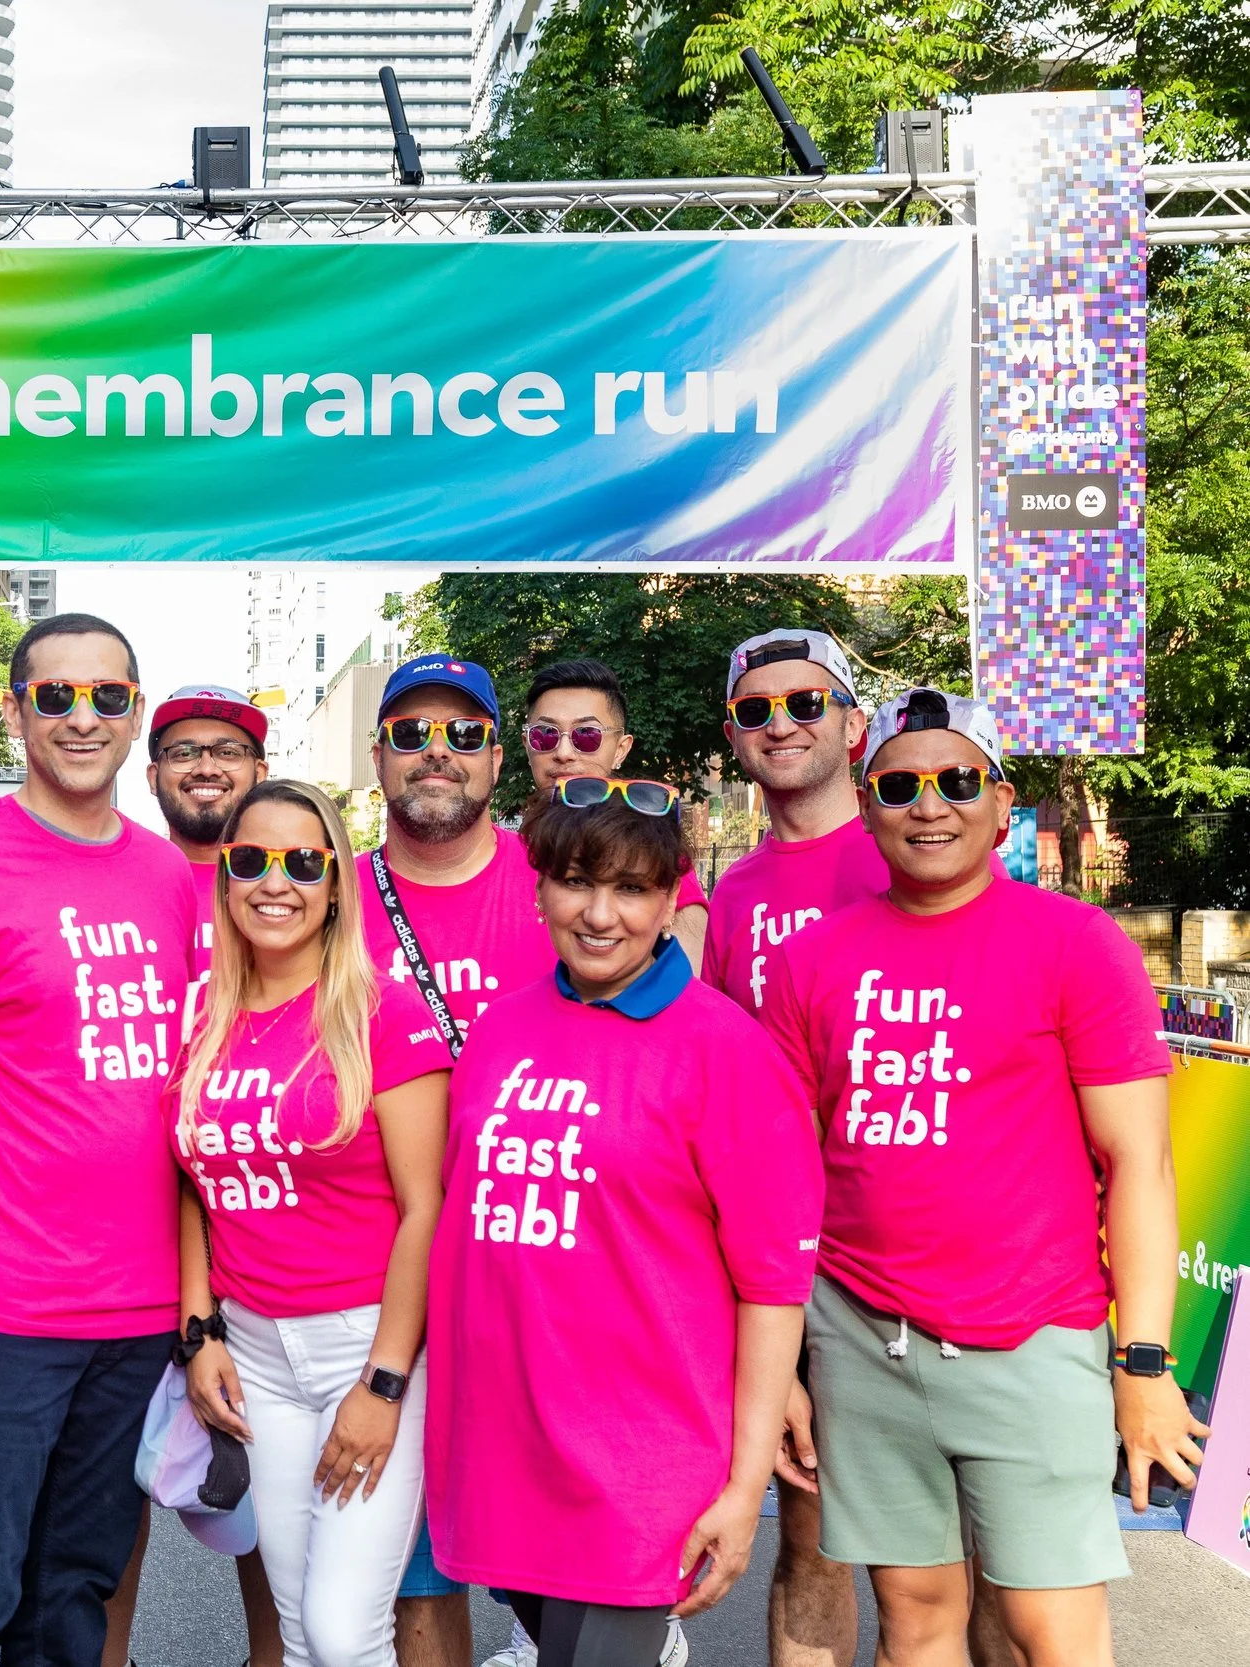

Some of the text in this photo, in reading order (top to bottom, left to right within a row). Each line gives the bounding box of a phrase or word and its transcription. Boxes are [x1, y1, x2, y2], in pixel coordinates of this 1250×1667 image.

[1009, 294, 1078, 320] run
[1007, 316, 1097, 366] with
[594, 369, 779, 436] run
[1008, 362, 1120, 424] pride
[1006, 423, 1119, 448] @priderunto
[1021, 494, 1071, 511] BMO
[413, 663, 444, 674] BMO
[372, 851, 390, 891] adidas
[59, 906, 158, 959] fun.
[393, 914, 420, 963] adidas
[75, 963, 176, 1020] fast.
[425, 988, 455, 1039] adidas
[854, 969, 963, 1024] fun.
[78, 1022, 170, 1081] fab!
[408, 1028, 433, 1044] BMO
[847, 1027, 972, 1086] fast.
[204, 1068, 286, 1100] un.
[494, 1058, 600, 1117] fun.
[846, 1088, 949, 1146] fab!
[476, 1113, 597, 1183] fast.
[191, 1159, 299, 1211] fab!
[471, 1178, 580, 1250] fab!
